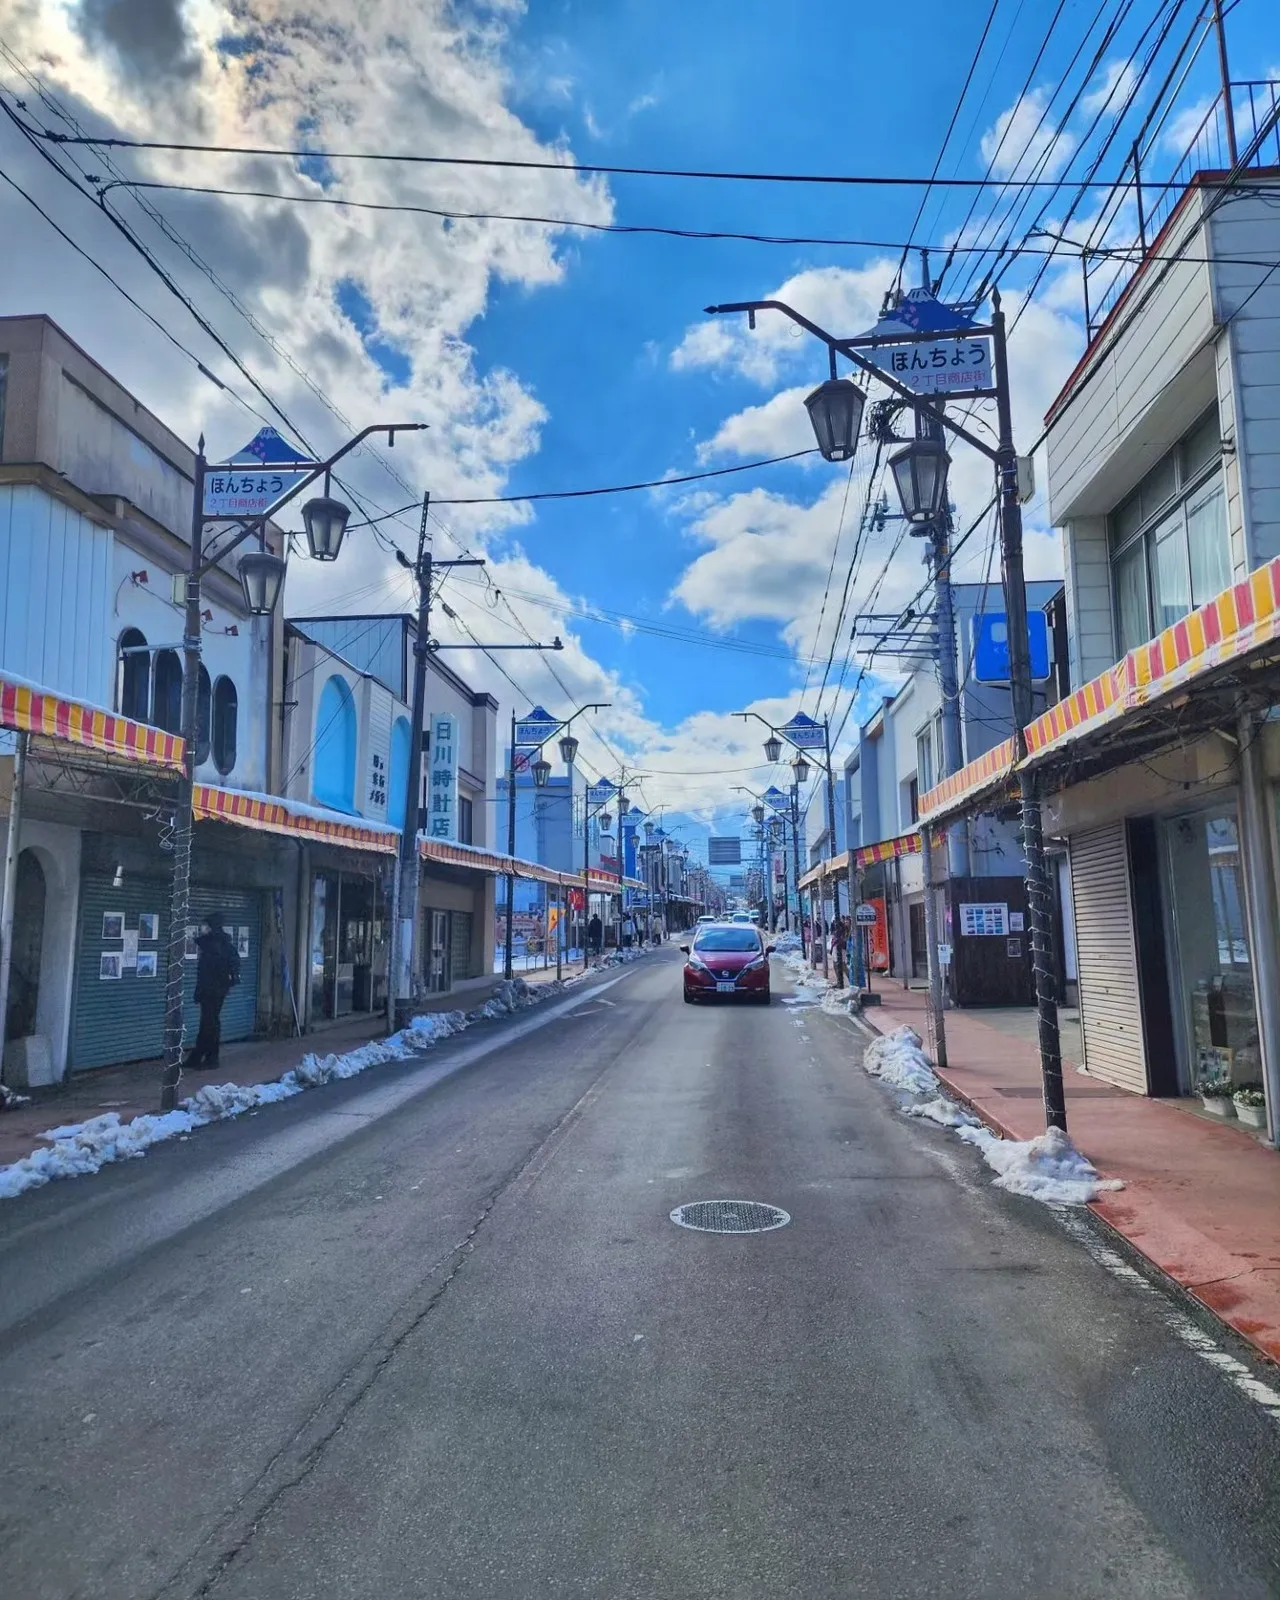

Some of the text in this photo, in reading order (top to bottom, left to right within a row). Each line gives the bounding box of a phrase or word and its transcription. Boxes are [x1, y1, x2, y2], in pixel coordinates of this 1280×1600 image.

[891, 344, 986, 372] ほんちょう
[211, 476, 283, 494] ほんちょう
[432, 721, 452, 836] 日川時計店
